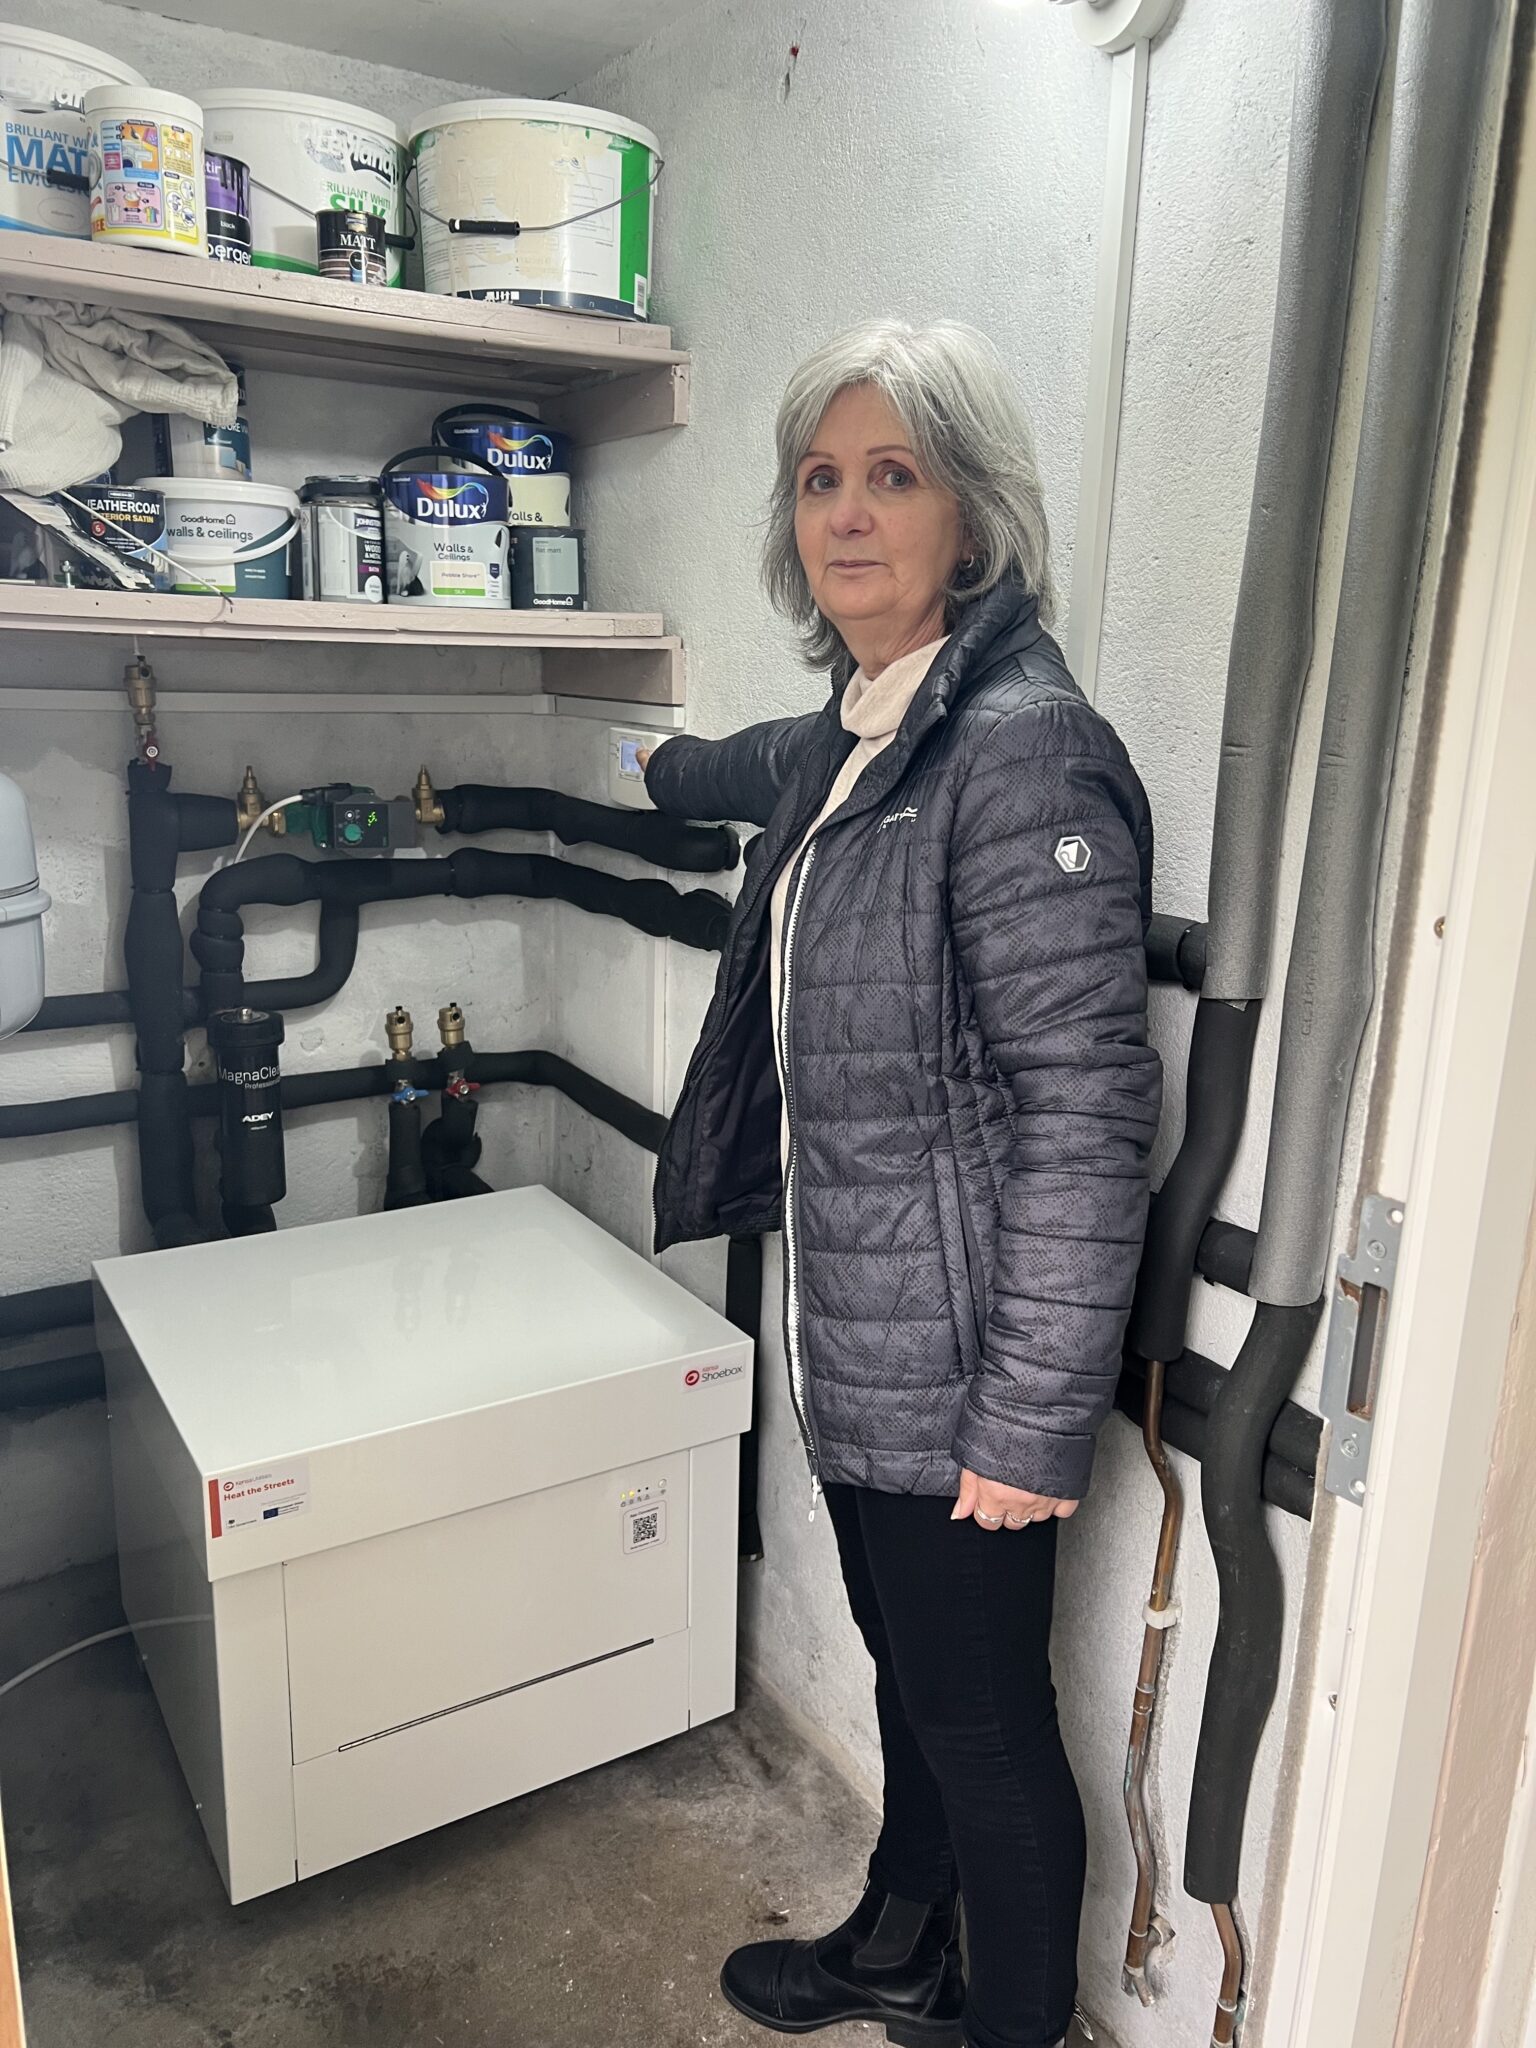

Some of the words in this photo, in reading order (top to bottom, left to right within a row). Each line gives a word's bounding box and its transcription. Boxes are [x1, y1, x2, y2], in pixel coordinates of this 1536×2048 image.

[5, 121, 69, 144] BRILLIANT
[6, 134, 89, 179] MAT
[322, 180, 369, 200] RILLIANT
[220, 220, 236, 230] black
[339, 233, 377, 251] MATT
[486, 447, 547, 471] Dulux
[87, 499, 161, 515] EATHERCOAT
[416, 497, 482, 520] Dulux
[91, 511, 131, 522] ETERIOR
[132, 514, 154, 524] SATIN
[180, 514, 226, 525] GoodHome
[534, 512, 544, 523] &
[166, 526, 194, 538] walls
[196, 526, 205, 538] &
[207, 528, 254, 543] ceilings
[433, 543, 466, 554] Walls
[467, 546, 475, 554] &
[437, 552, 471, 562] Ceilings
[532, 598, 567, 607] GoodHome
[242, 1111, 274, 1123] ADEY
[701, 1365, 744, 1383] Shoebox
[223, 1491, 246, 1502] Heat
[247, 1486, 262, 1496] the
[263, 1478, 296, 1492] Streets
